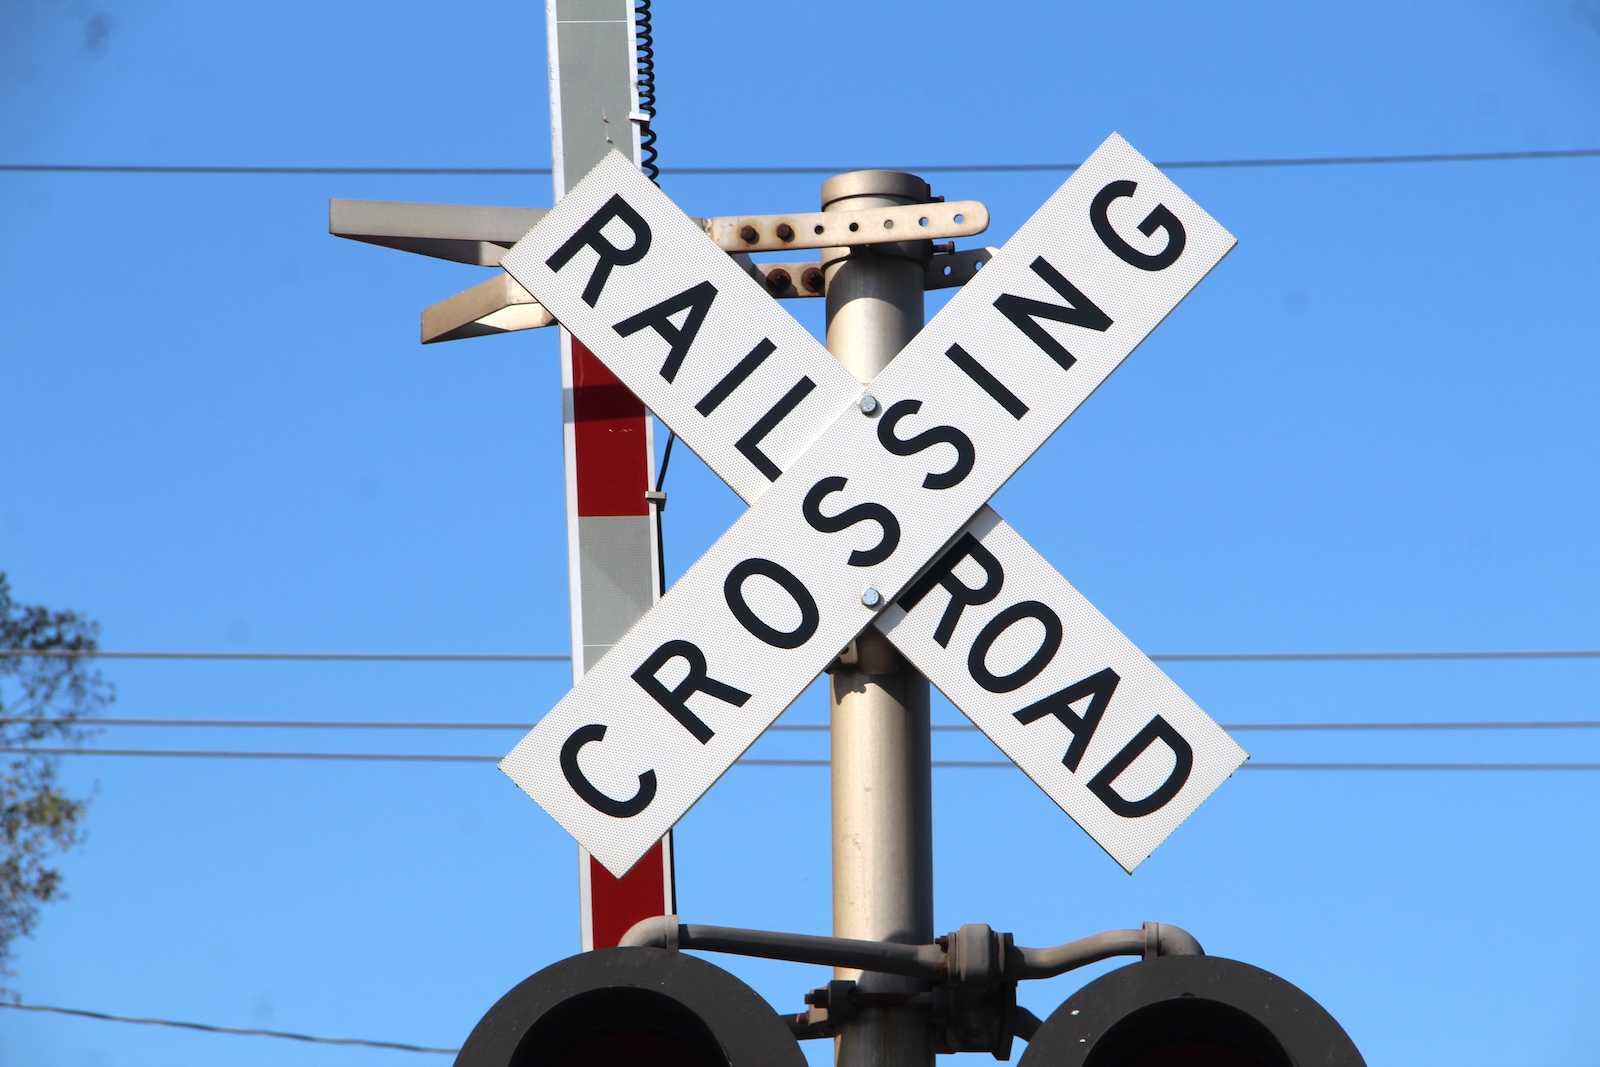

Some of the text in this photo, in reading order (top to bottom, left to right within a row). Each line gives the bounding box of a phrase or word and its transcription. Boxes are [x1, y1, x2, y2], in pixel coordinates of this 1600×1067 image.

[546, 193, 1193, 818] RAIL ROAD
[560, 180, 1187, 819] CROSSING
